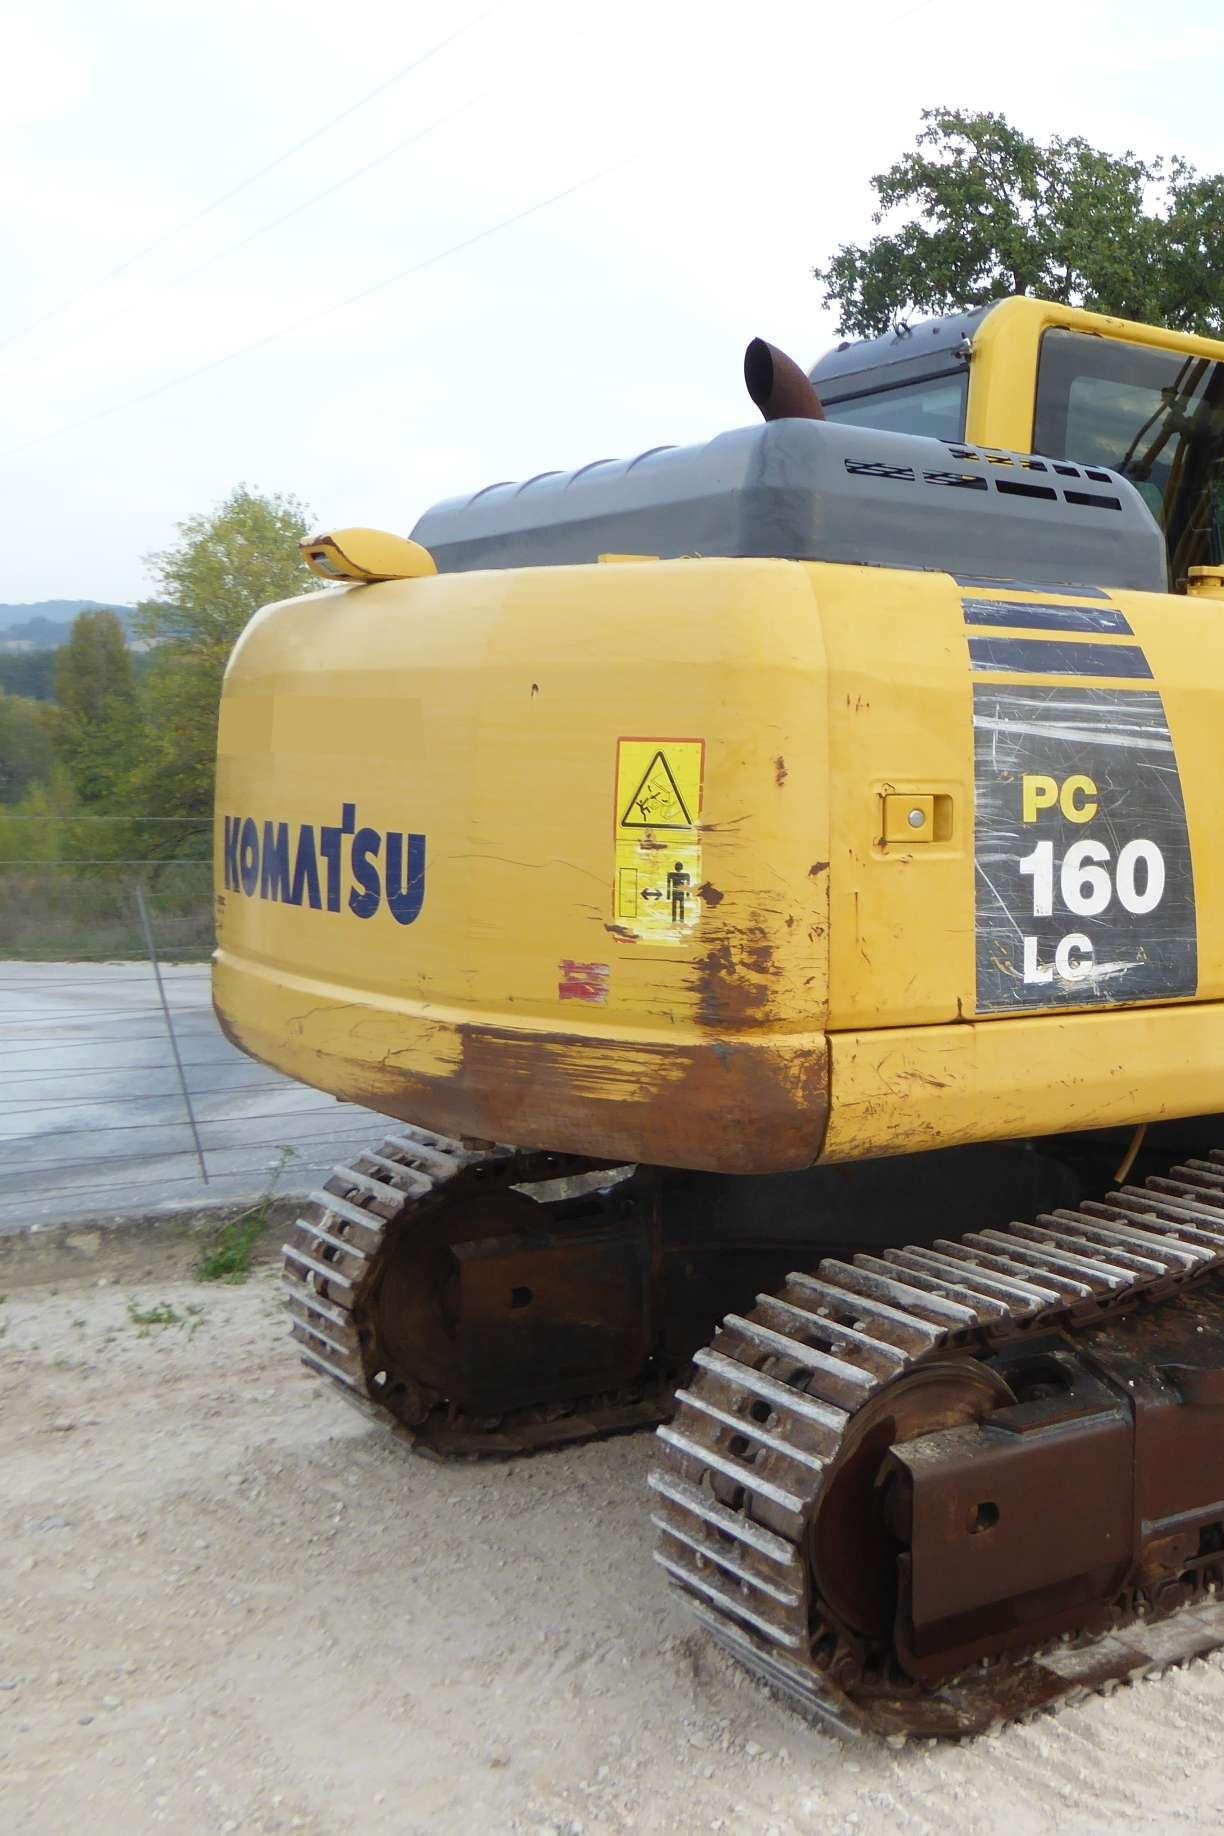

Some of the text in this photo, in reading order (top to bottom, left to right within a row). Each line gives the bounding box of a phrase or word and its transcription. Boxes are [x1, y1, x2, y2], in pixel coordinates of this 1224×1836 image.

[1022, 774, 1099, 824] PC
[224, 802, 426, 926] KOMATSU
[1019, 839, 1166, 917] 160
[1023, 932, 1096, 984] LC
